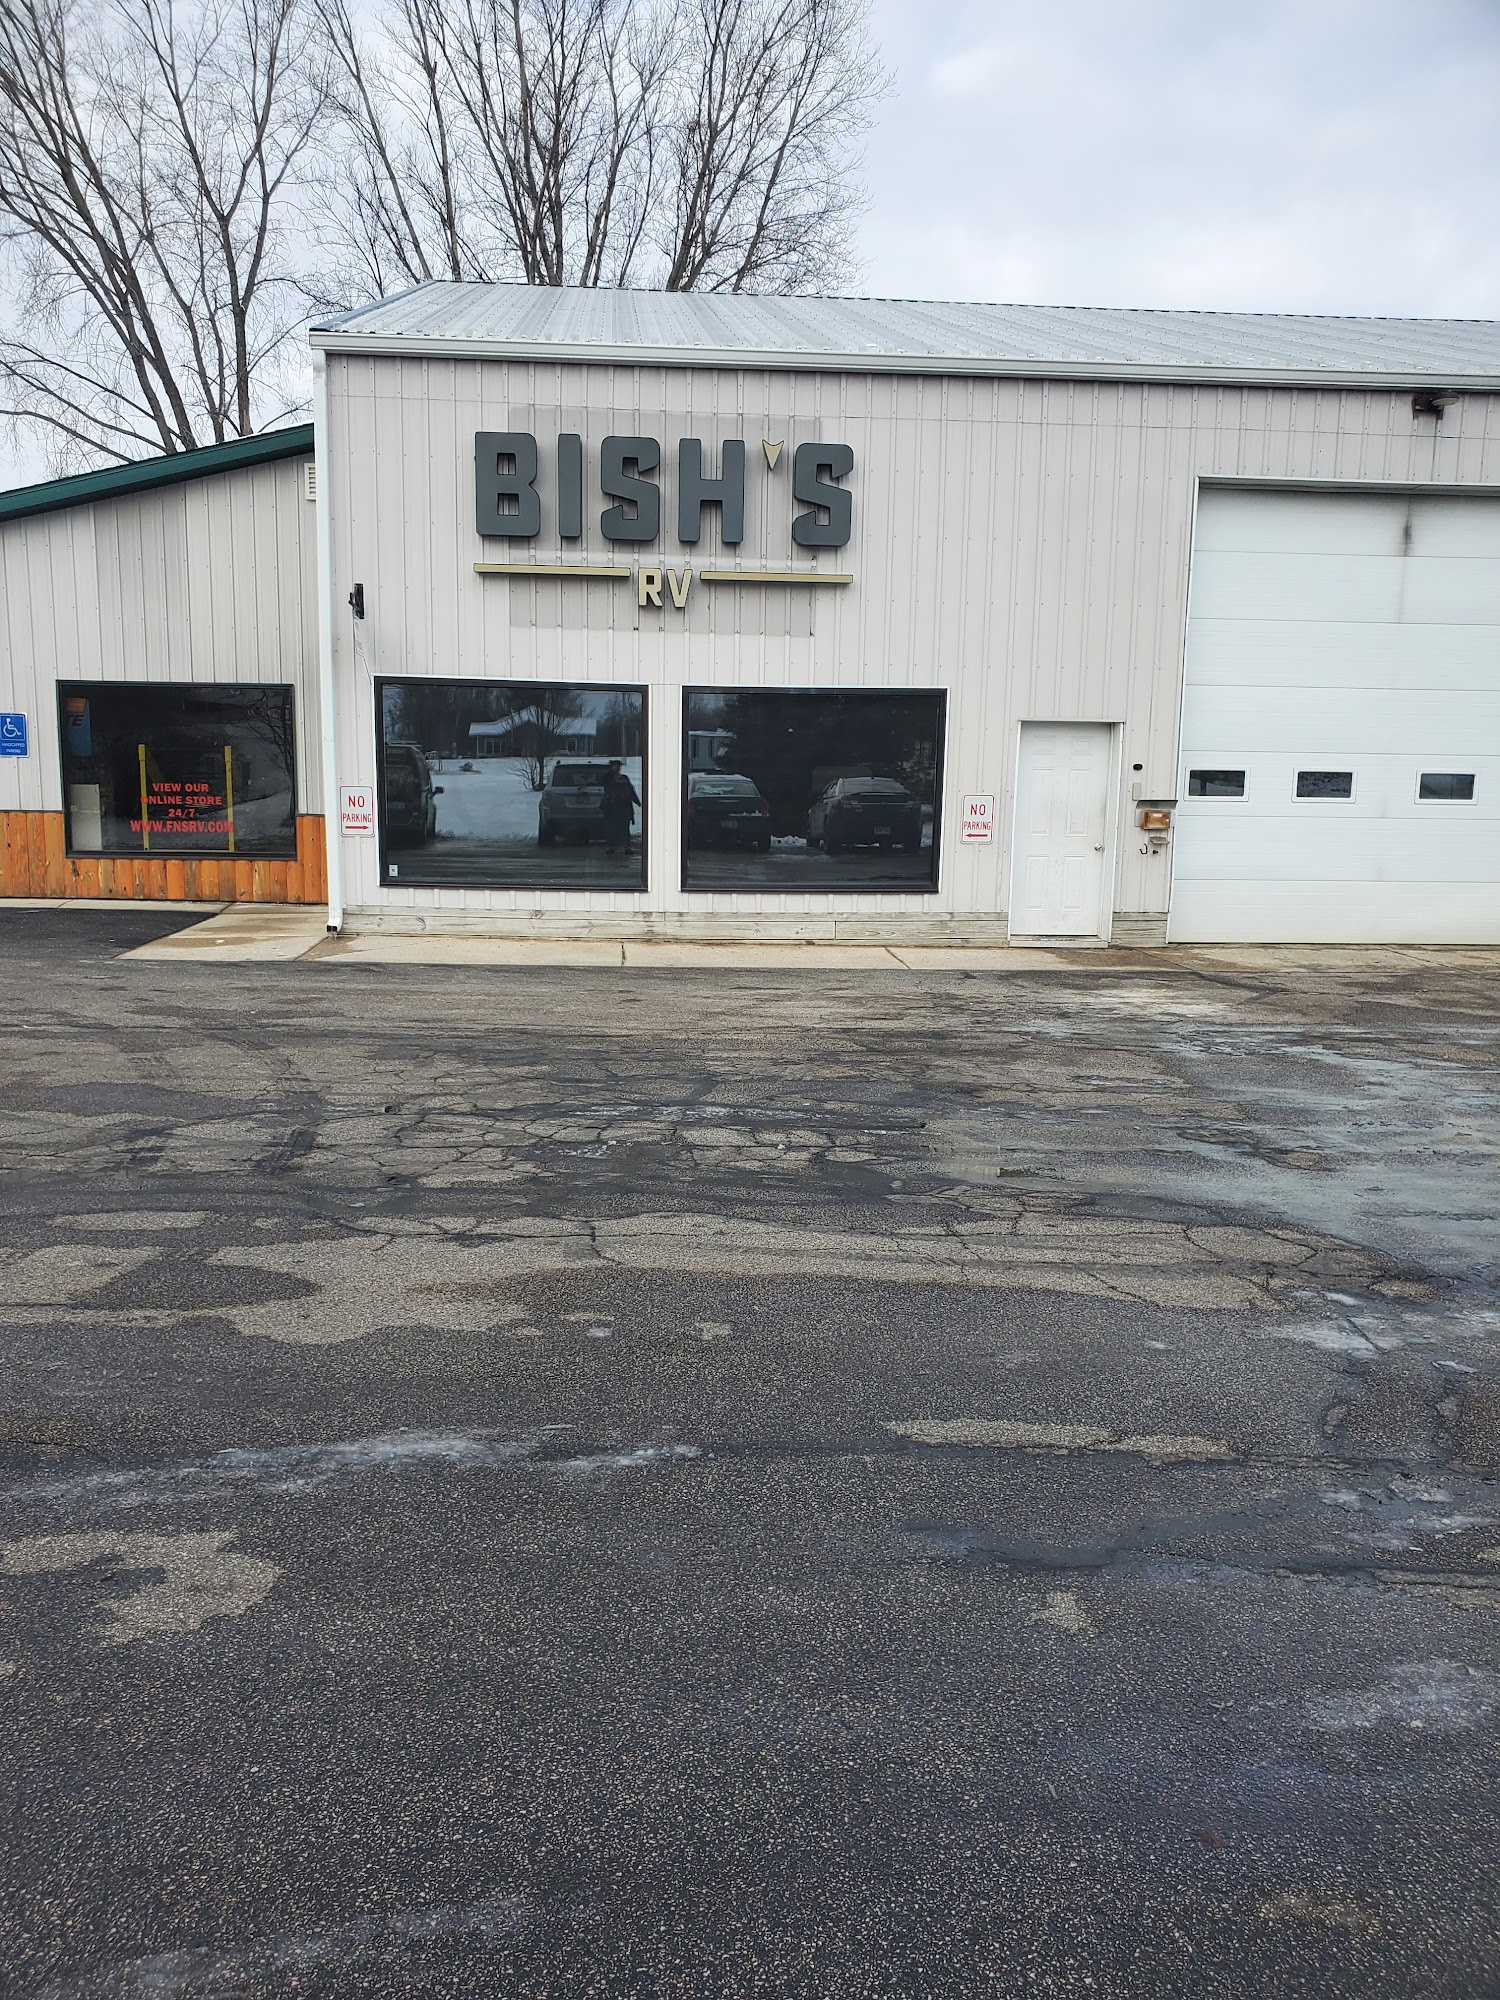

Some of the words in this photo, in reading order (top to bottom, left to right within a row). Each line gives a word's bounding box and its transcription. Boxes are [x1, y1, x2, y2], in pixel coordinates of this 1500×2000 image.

[475, 431, 854, 547] BISH'S
[638, 567, 692, 608] RV
[152, 783, 181, 792] VIEW
[184, 783, 209, 792] OUR
[141, 795, 182, 805] ONLINE
[185, 796, 222, 806] STORE
[348, 795, 365, 808] NO
[168, 808, 196, 818] 24/7
[970, 803, 986, 816] NO
[342, 813, 372, 823] PARKING
[130, 820, 234, 833] WWW.FNSRV.COM
[963, 821, 991, 831] PARKING
